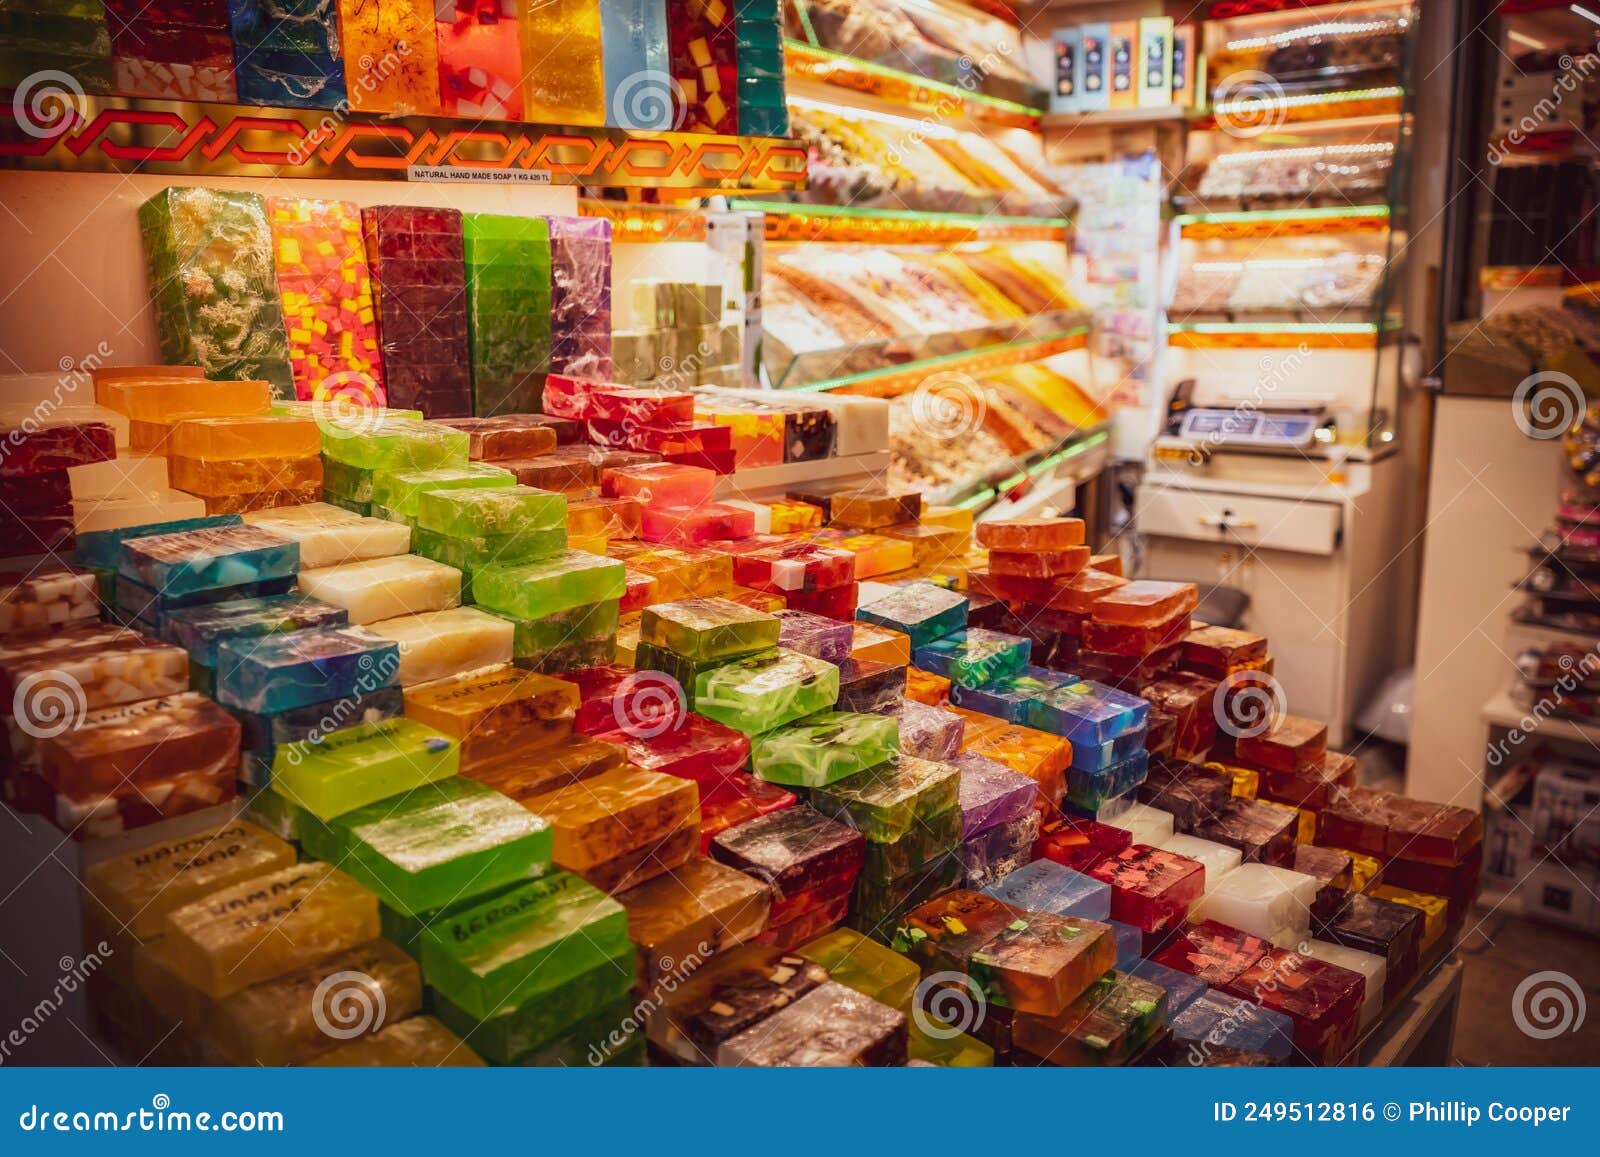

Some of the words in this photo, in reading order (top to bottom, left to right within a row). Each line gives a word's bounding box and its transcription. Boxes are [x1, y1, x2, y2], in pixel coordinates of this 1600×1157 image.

[414, 170, 449, 179] NATURAL
[450, 171, 470, 180] HAND
[472, 171, 491, 180] MADE
[493, 172, 512, 181] SOAP
[513, 173, 517, 181] 1
[519, 173, 529, 181] KG
